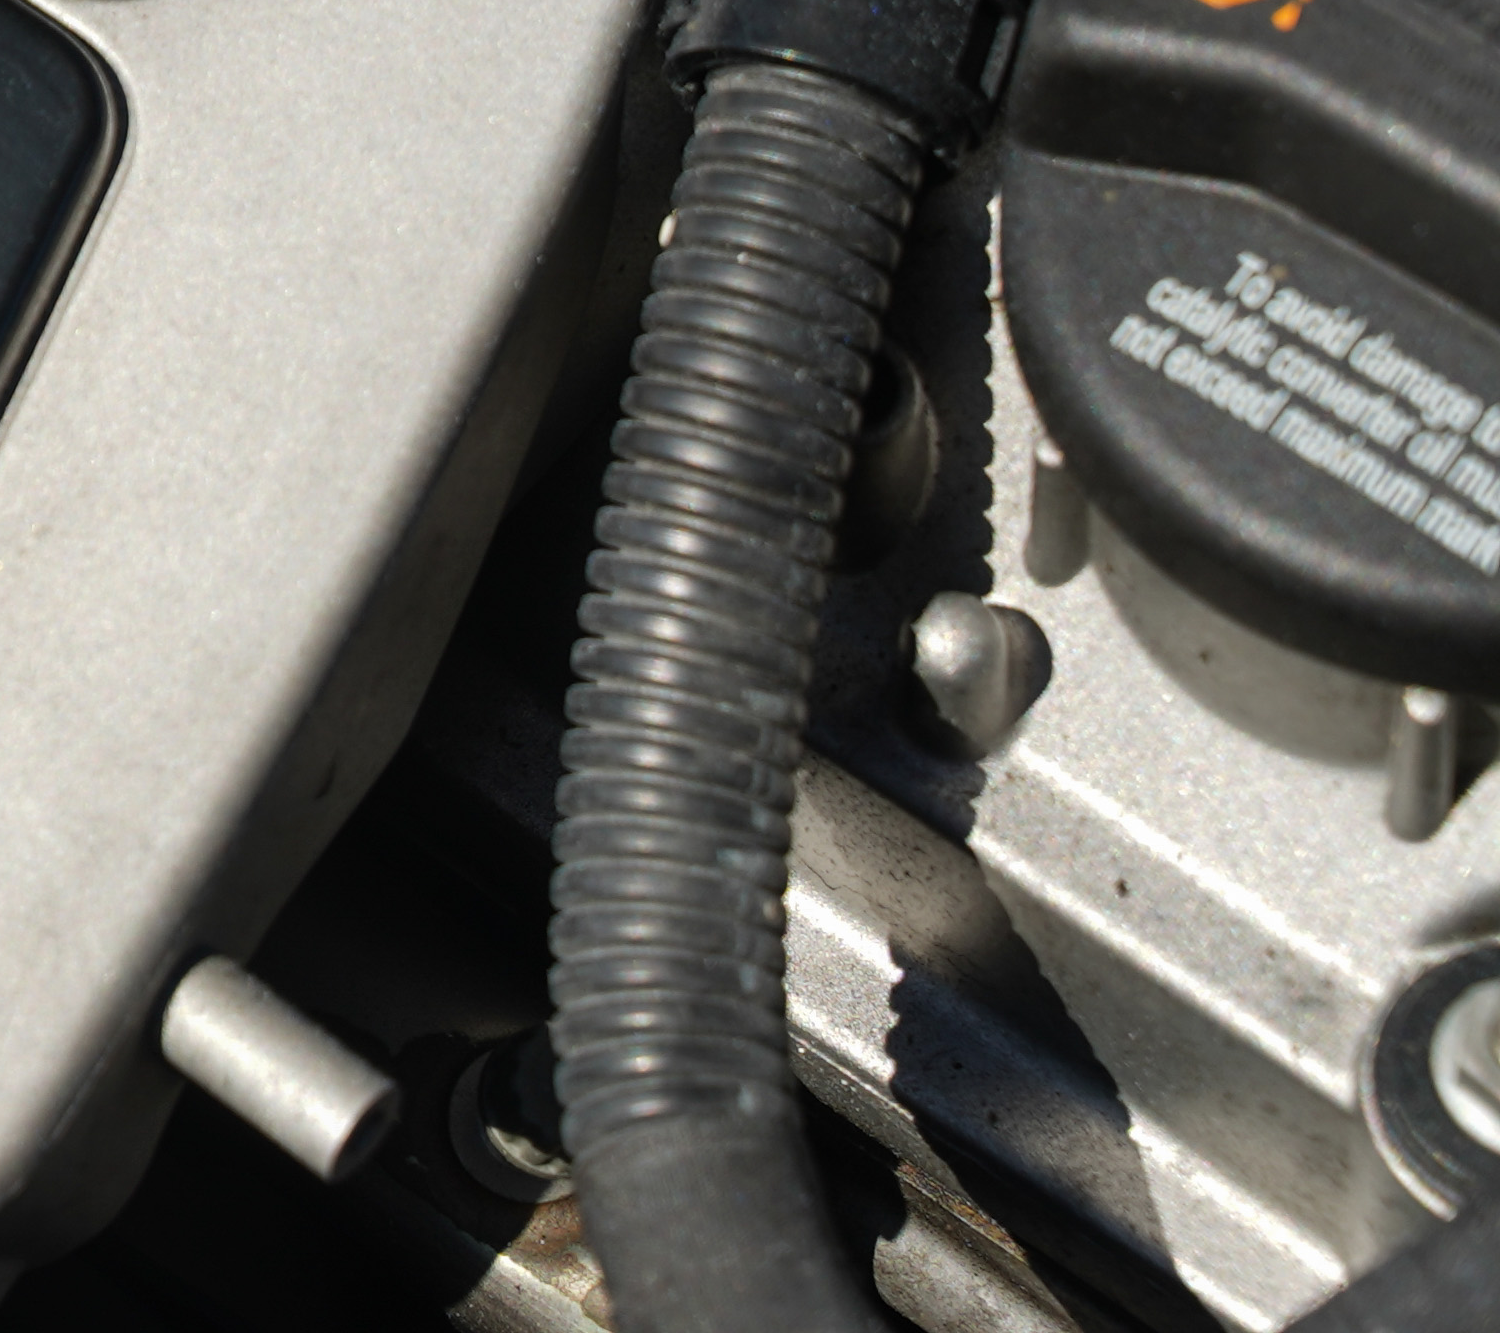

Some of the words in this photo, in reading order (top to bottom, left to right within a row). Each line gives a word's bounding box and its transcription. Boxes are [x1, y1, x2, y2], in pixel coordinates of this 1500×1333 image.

[1109, 313, 1179, 371] not
[1163, 343, 1292, 432] exceed
[1268, 405, 1431, 524] maximum
[1146, 276, 1278, 369] catalytic
[1266, 344, 1421, 454] converter
[1405, 429, 1466, 480] oil
[1223, 251, 1276, 310] To
[1263, 287, 1368, 360] avoid
[1348, 331, 1484, 434] damage
